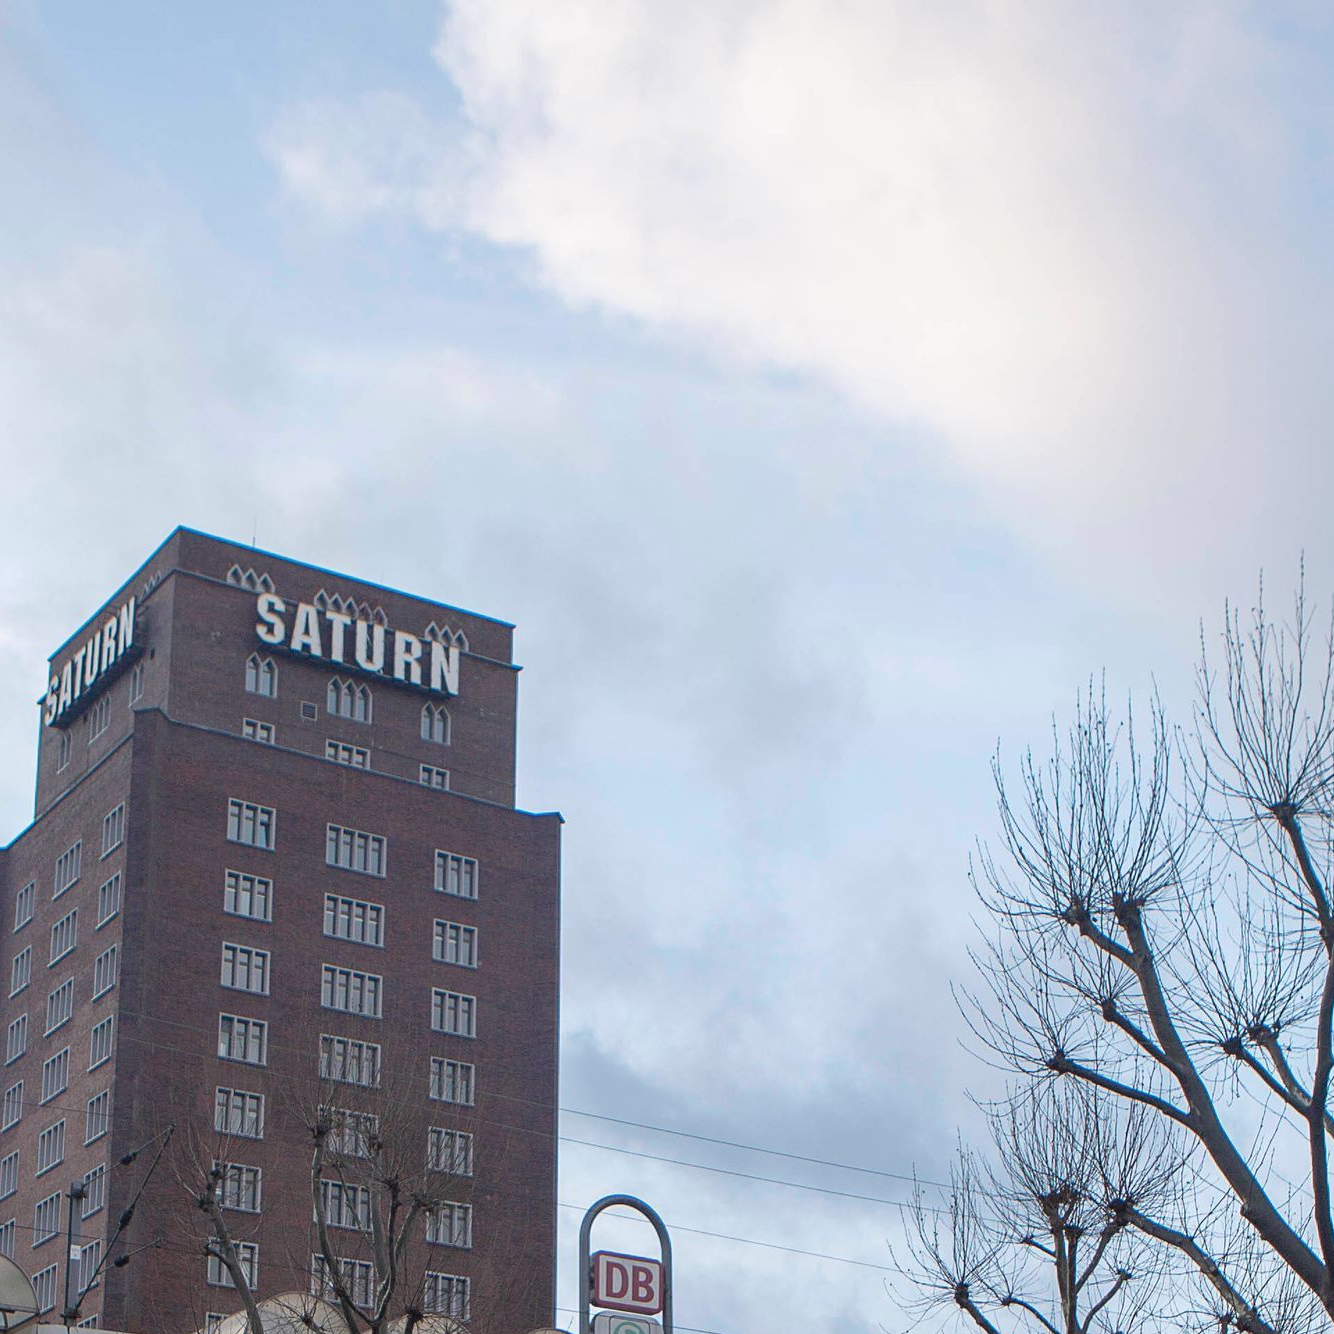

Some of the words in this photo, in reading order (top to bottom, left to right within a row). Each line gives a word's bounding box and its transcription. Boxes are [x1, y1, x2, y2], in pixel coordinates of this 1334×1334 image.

[44, 597, 137, 726] SATURN
[255, 593, 461, 697] SATURN
[604, 1260, 656, 1304] DB
